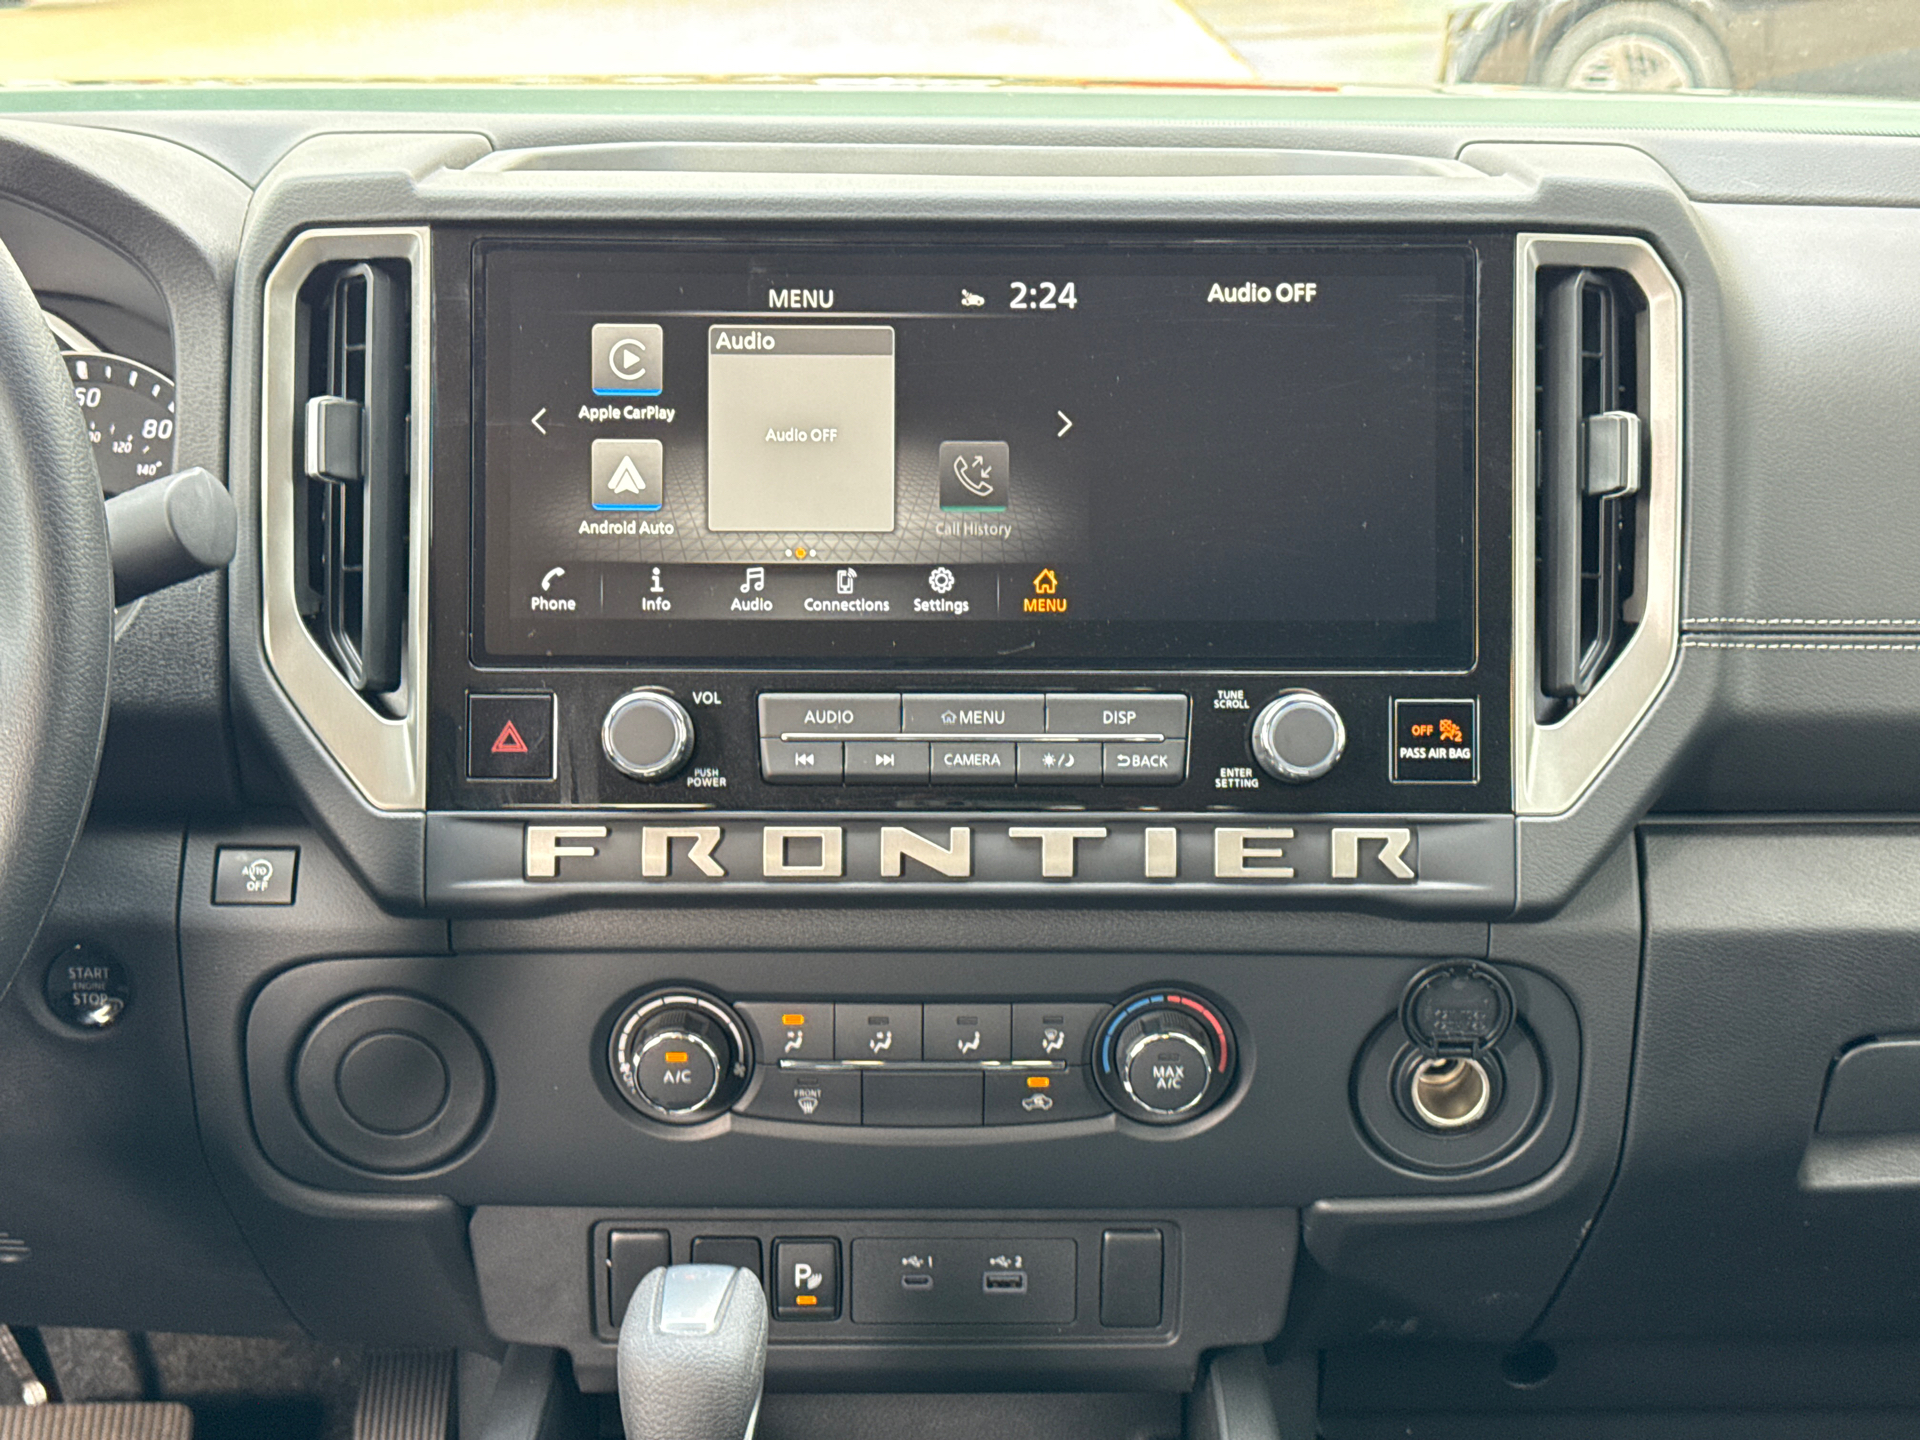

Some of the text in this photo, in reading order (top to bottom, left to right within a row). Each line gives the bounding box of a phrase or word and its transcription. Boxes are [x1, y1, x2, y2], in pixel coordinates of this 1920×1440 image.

[768, 289, 834, 308] MENU
[1010, 282, 1077, 309] 2:24
[1207, 282, 1316, 302] Audio OFF
[716, 332, 775, 350] Audio
[579, 405, 675, 422] Apple CarPlay
[142, 419, 172, 439] 80
[765, 427, 837, 442] Audio OFF
[113, 441, 132, 453] 120
[137, 464, 156, 475] 140
[579, 520, 674, 535] Android Auto
[935, 521, 1011, 538] Call History
[532, 596, 576, 610] Phone
[642, 597, 671, 610] Info
[731, 597, 773, 611] Audio
[804, 596, 889, 611] Connections
[914, 598, 969, 614] Settings
[1024, 598, 1067, 612] MENU
[693, 691, 721, 704] VOL
[1216, 690, 1243, 700] TUNE
[1214, 698, 1249, 709] SCROLL
[804, 710, 853, 723] AUDIO
[960, 710, 1005, 724] MENU
[1103, 711, 1136, 724] DISP
[1411, 725, 1433, 736] OFF
[1400, 747, 1471, 759] PASS AIR BAG
[944, 754, 1000, 766] CAMERA
[1132, 755, 1168, 768] BACK
[695, 768, 718, 777] PUSH
[1221, 768, 1252, 777] ENTER
[687, 776, 726, 787] POWER
[1215, 778, 1258, 788] SETTING
[526, 826, 1414, 878] FRONTIER
[246, 881, 268, 892] OFF
[69, 966, 109, 979] START
[73, 992, 108, 1006] STOP
[664, 1070, 690, 1083] A/C
[1153, 1066, 1184, 1078] MAX
[1156, 1077, 1182, 1089] A/C
[794, 1089, 821, 1099] FRONT
[928, 1255, 934, 1268] 1
